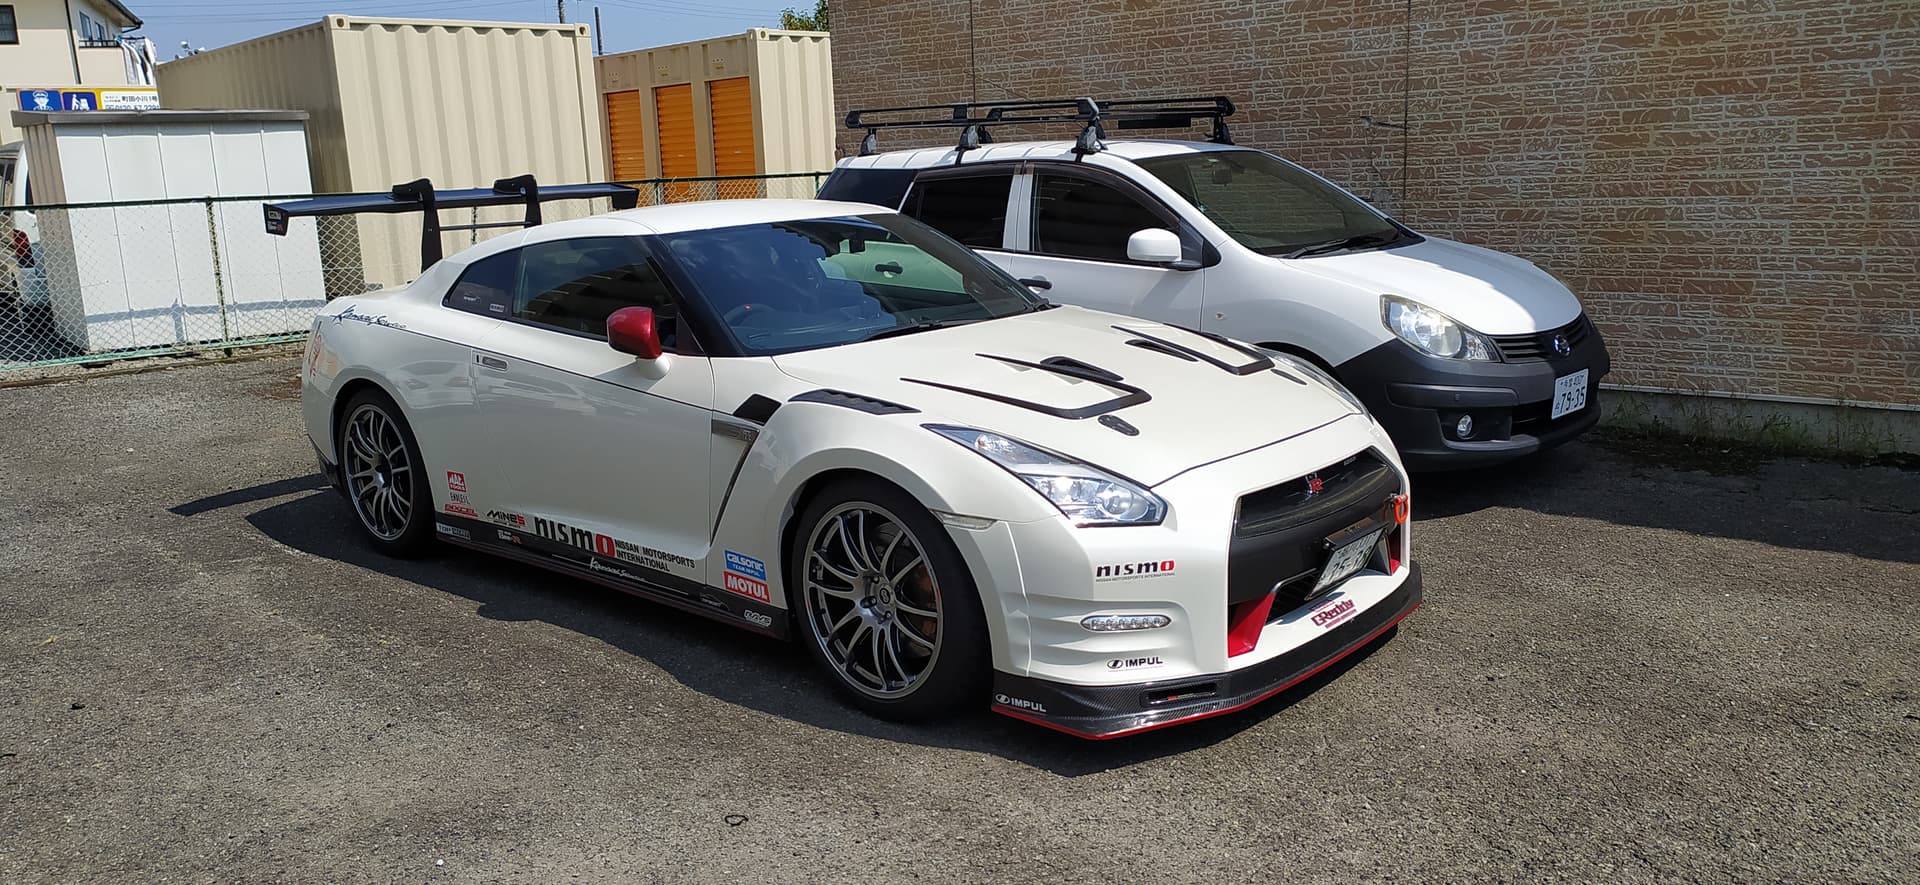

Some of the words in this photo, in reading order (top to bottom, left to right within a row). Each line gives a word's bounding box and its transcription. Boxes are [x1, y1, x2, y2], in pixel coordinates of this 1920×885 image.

[1560, 386, 1585, 413] 79-35
[614, 538, 640, 554] NISSAN
[642, 545, 696, 569] MOTORSPORTS
[616, 548, 671, 573] INTERNATIONAL
[727, 575, 768, 600] MOTUL
[1125, 656, 1163, 667] IMPUL
[1011, 697, 1047, 713] IMPUL
